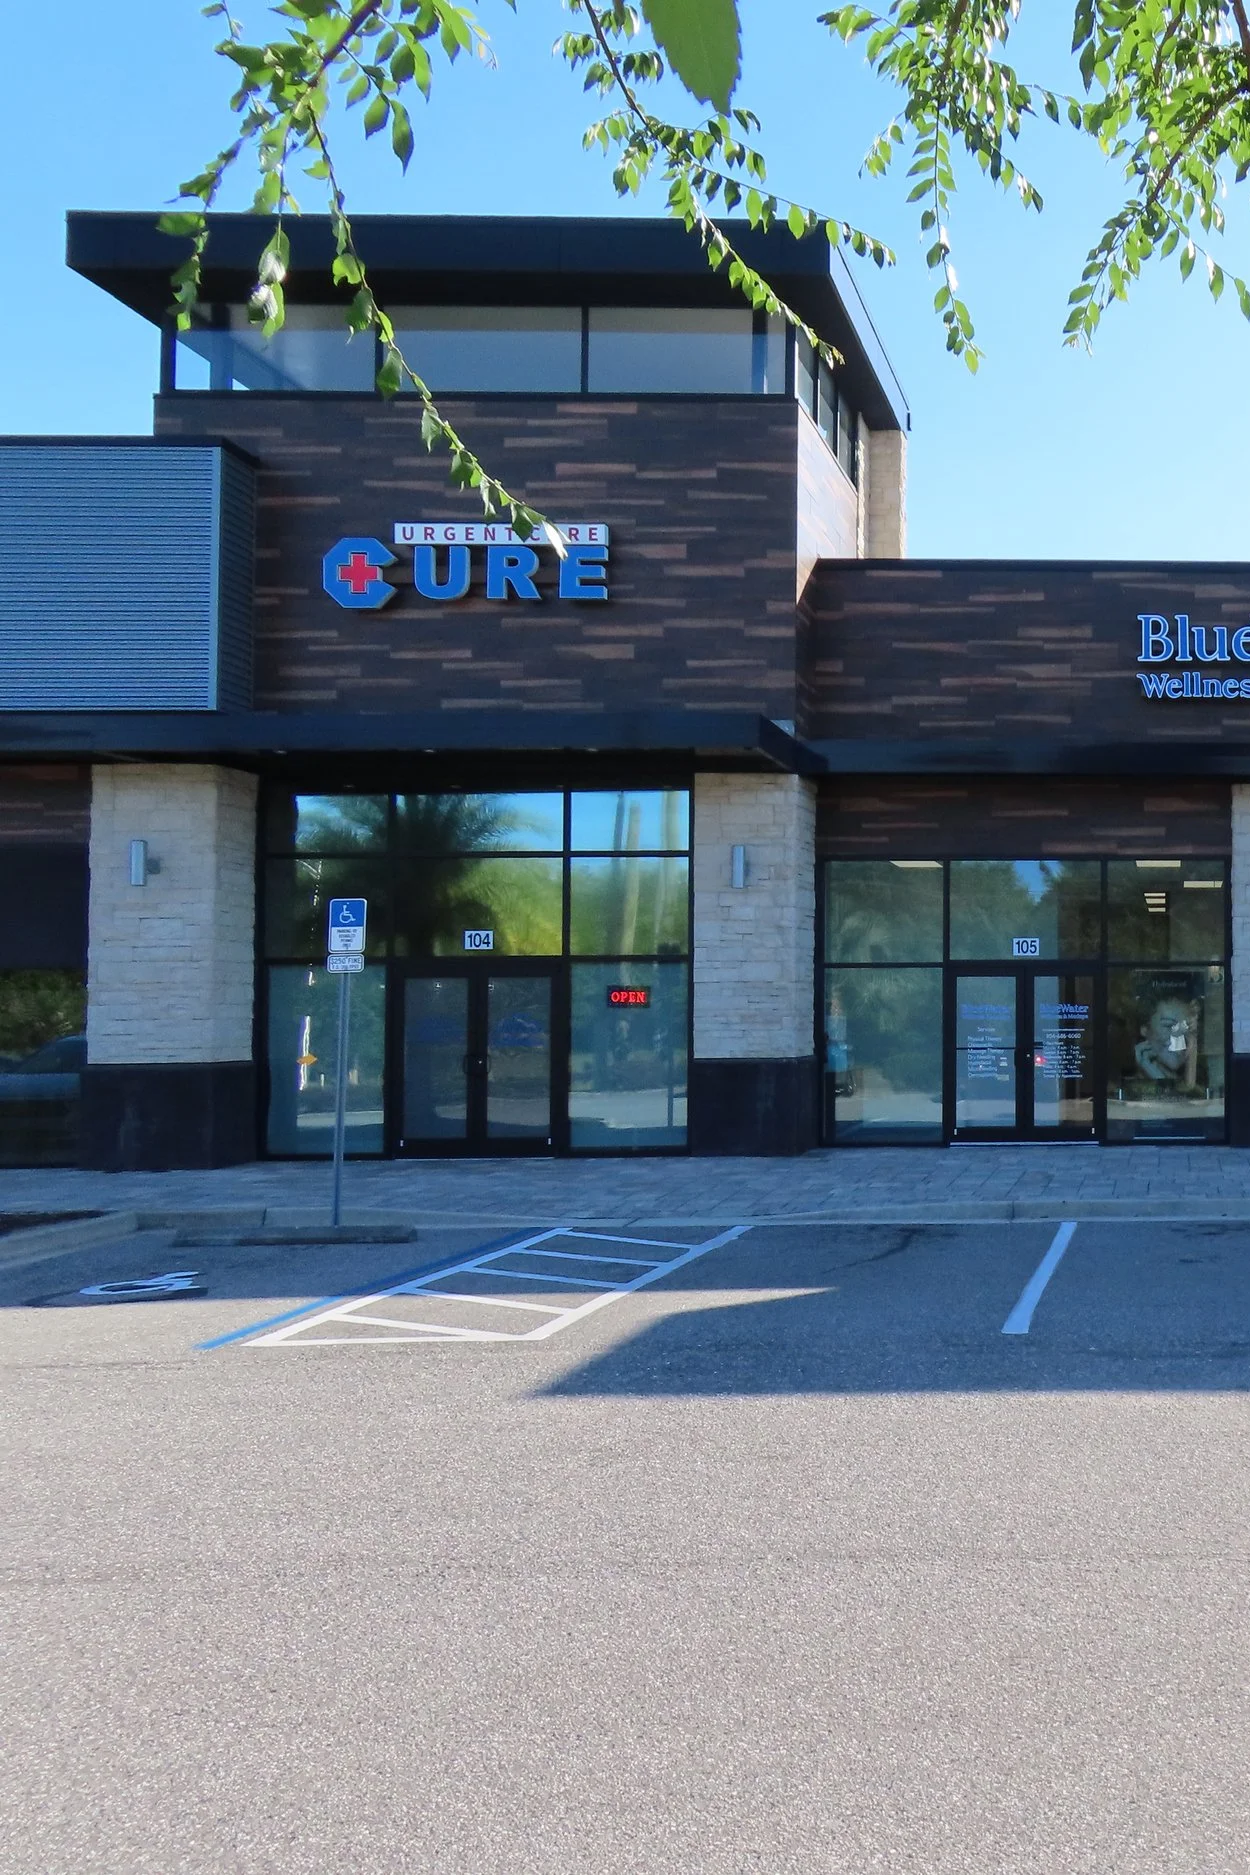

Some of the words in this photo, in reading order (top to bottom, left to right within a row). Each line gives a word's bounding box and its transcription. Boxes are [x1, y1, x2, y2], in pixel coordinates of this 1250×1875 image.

[402, 526, 514, 541] URGENT
[531, 526, 598, 541] CRE
[322, 537, 608, 608] CURE
[467, 933, 491, 948] 104
[1015, 940, 1037, 954] 105
[611, 991, 646, 1003] OPEN
